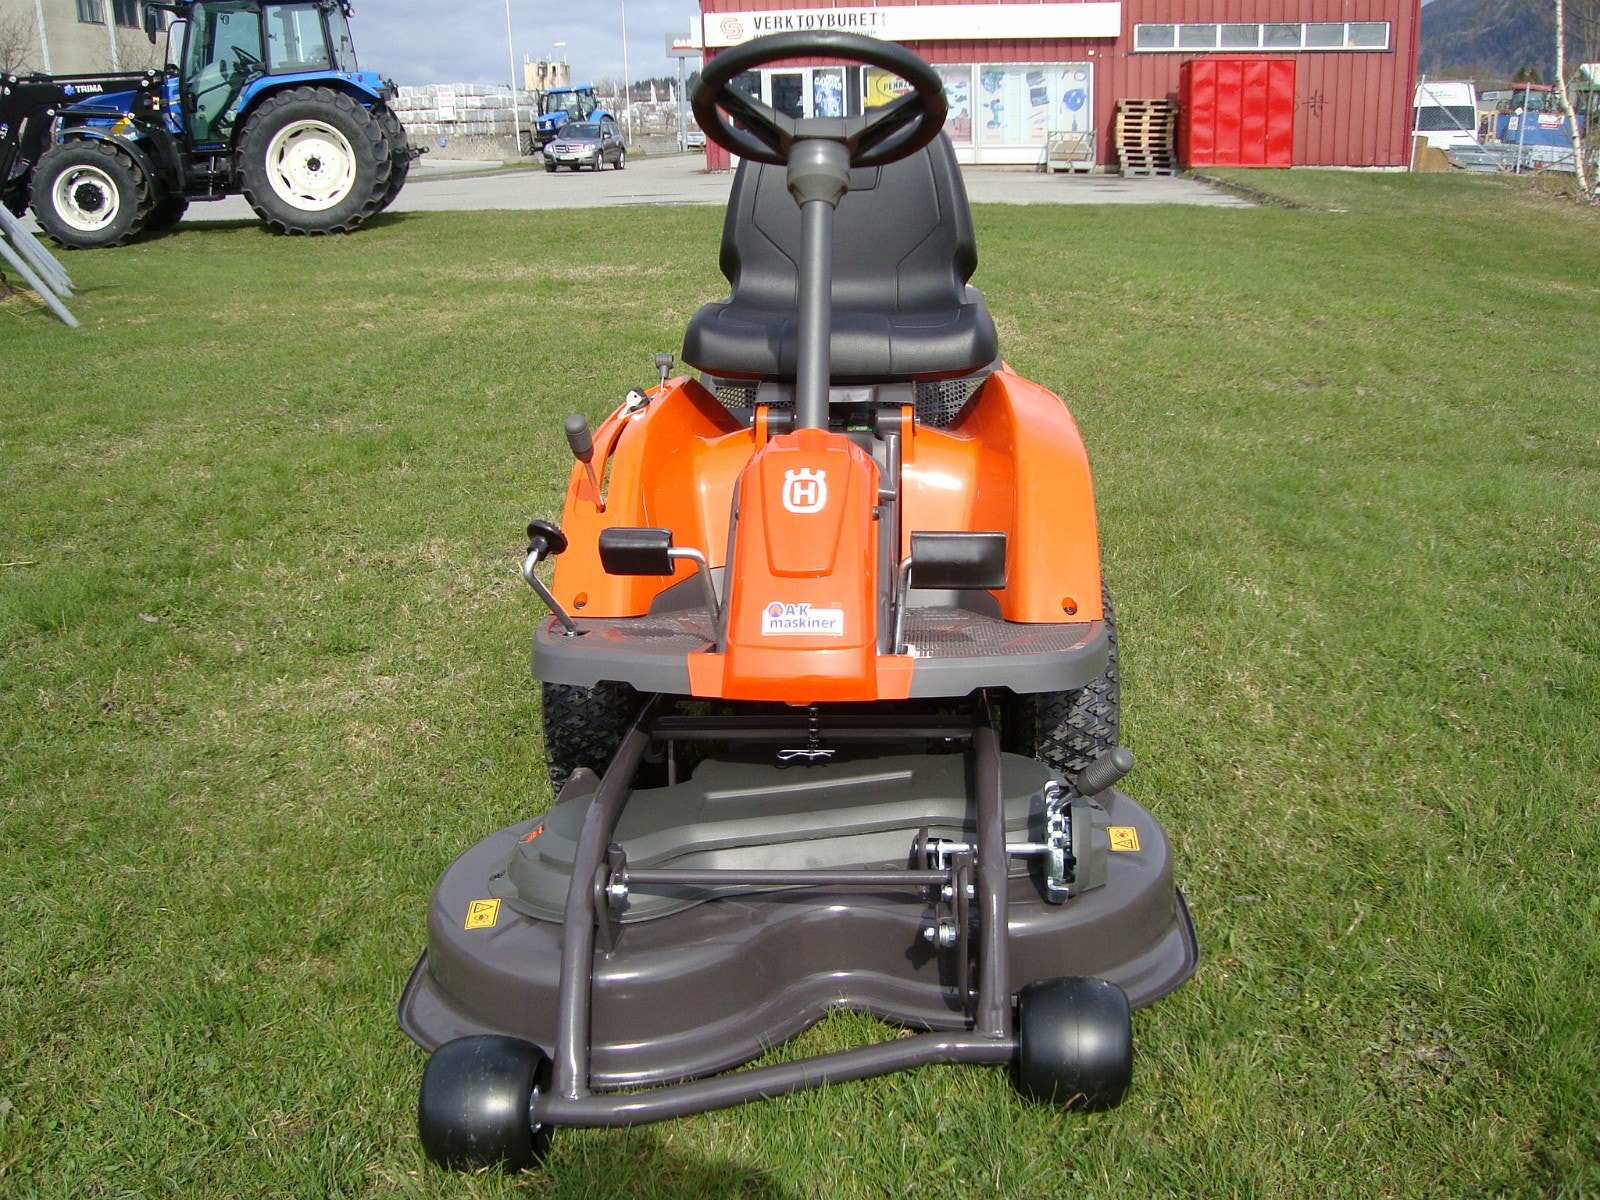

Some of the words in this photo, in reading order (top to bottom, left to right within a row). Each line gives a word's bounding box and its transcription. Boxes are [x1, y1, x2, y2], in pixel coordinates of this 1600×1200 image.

[753, 12, 878, 30] VERKTØYBURET
[75, 84, 104, 94] TRIMA
[770, 616, 836, 629] maskiner
